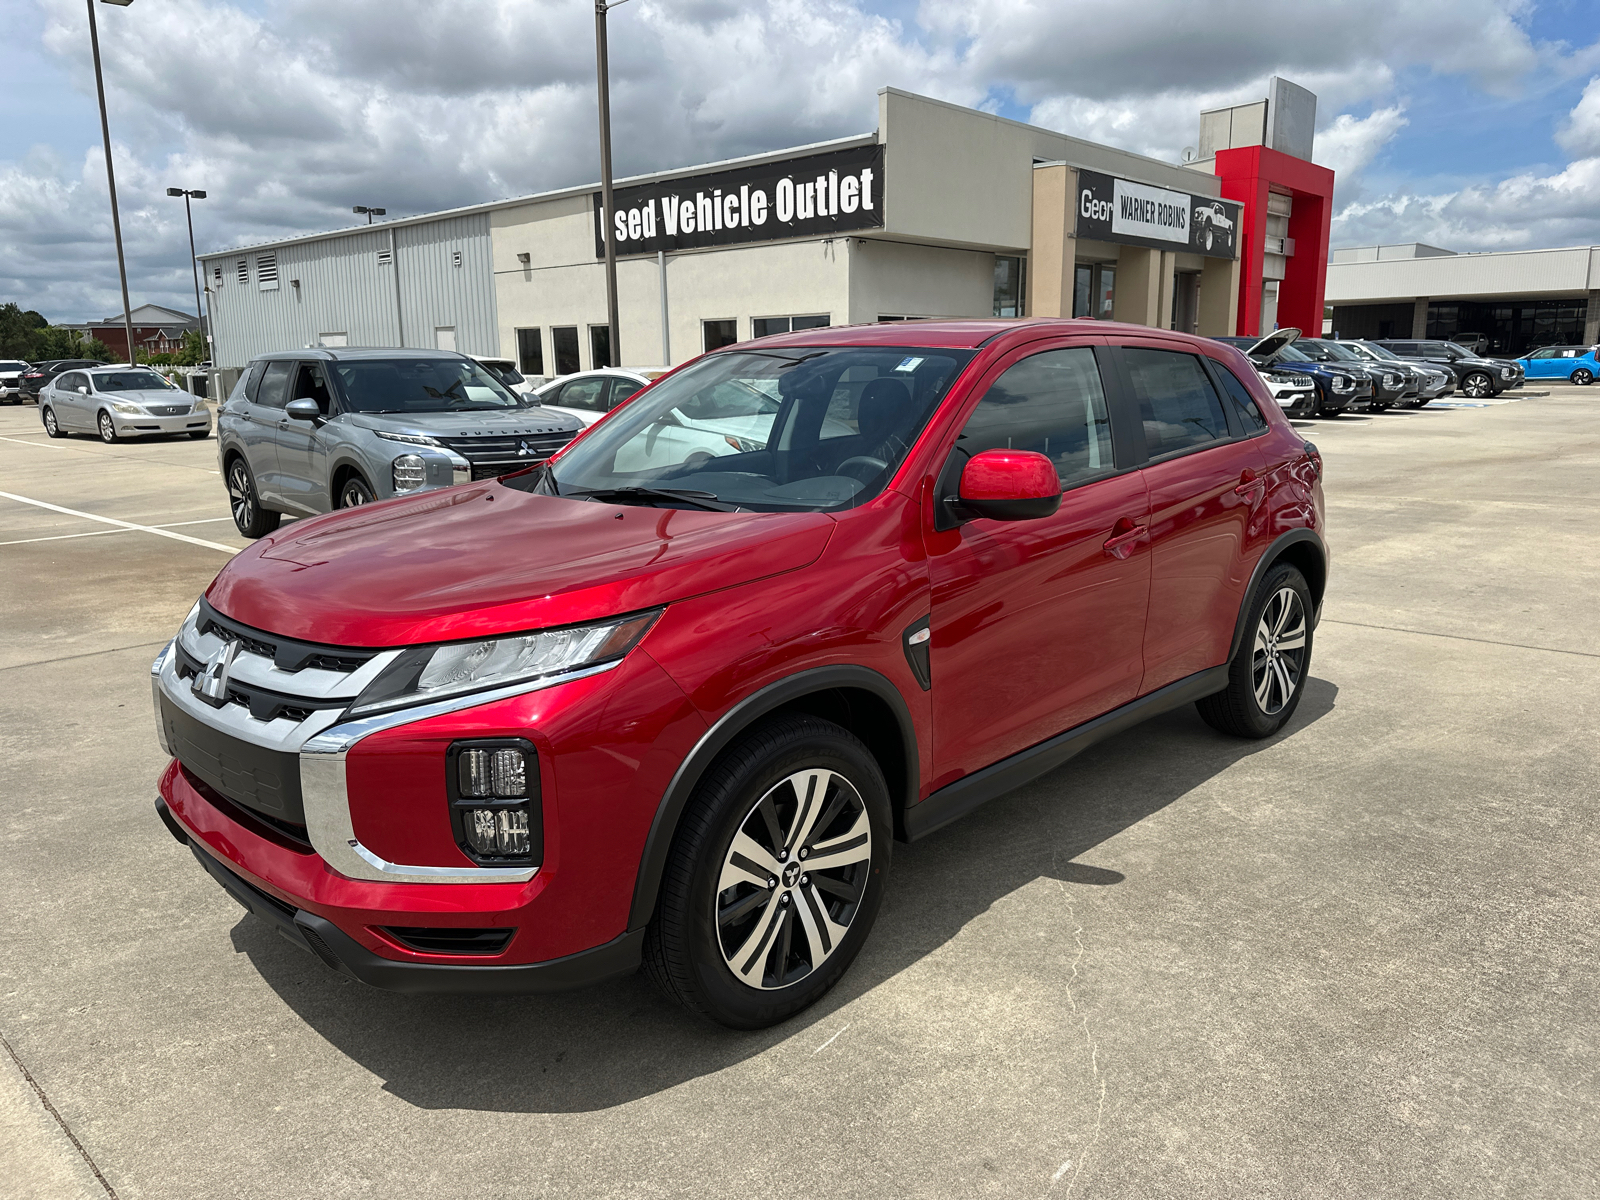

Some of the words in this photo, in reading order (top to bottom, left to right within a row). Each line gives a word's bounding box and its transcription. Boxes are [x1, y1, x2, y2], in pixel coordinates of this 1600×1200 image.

[661, 185, 768, 236] Vehicle
[775, 167, 874, 222] Outlet
[1120, 195, 1156, 224] WARNER
[1157, 202, 1186, 230] ROBINS
[460, 427, 564, 436] OUTLANDER
